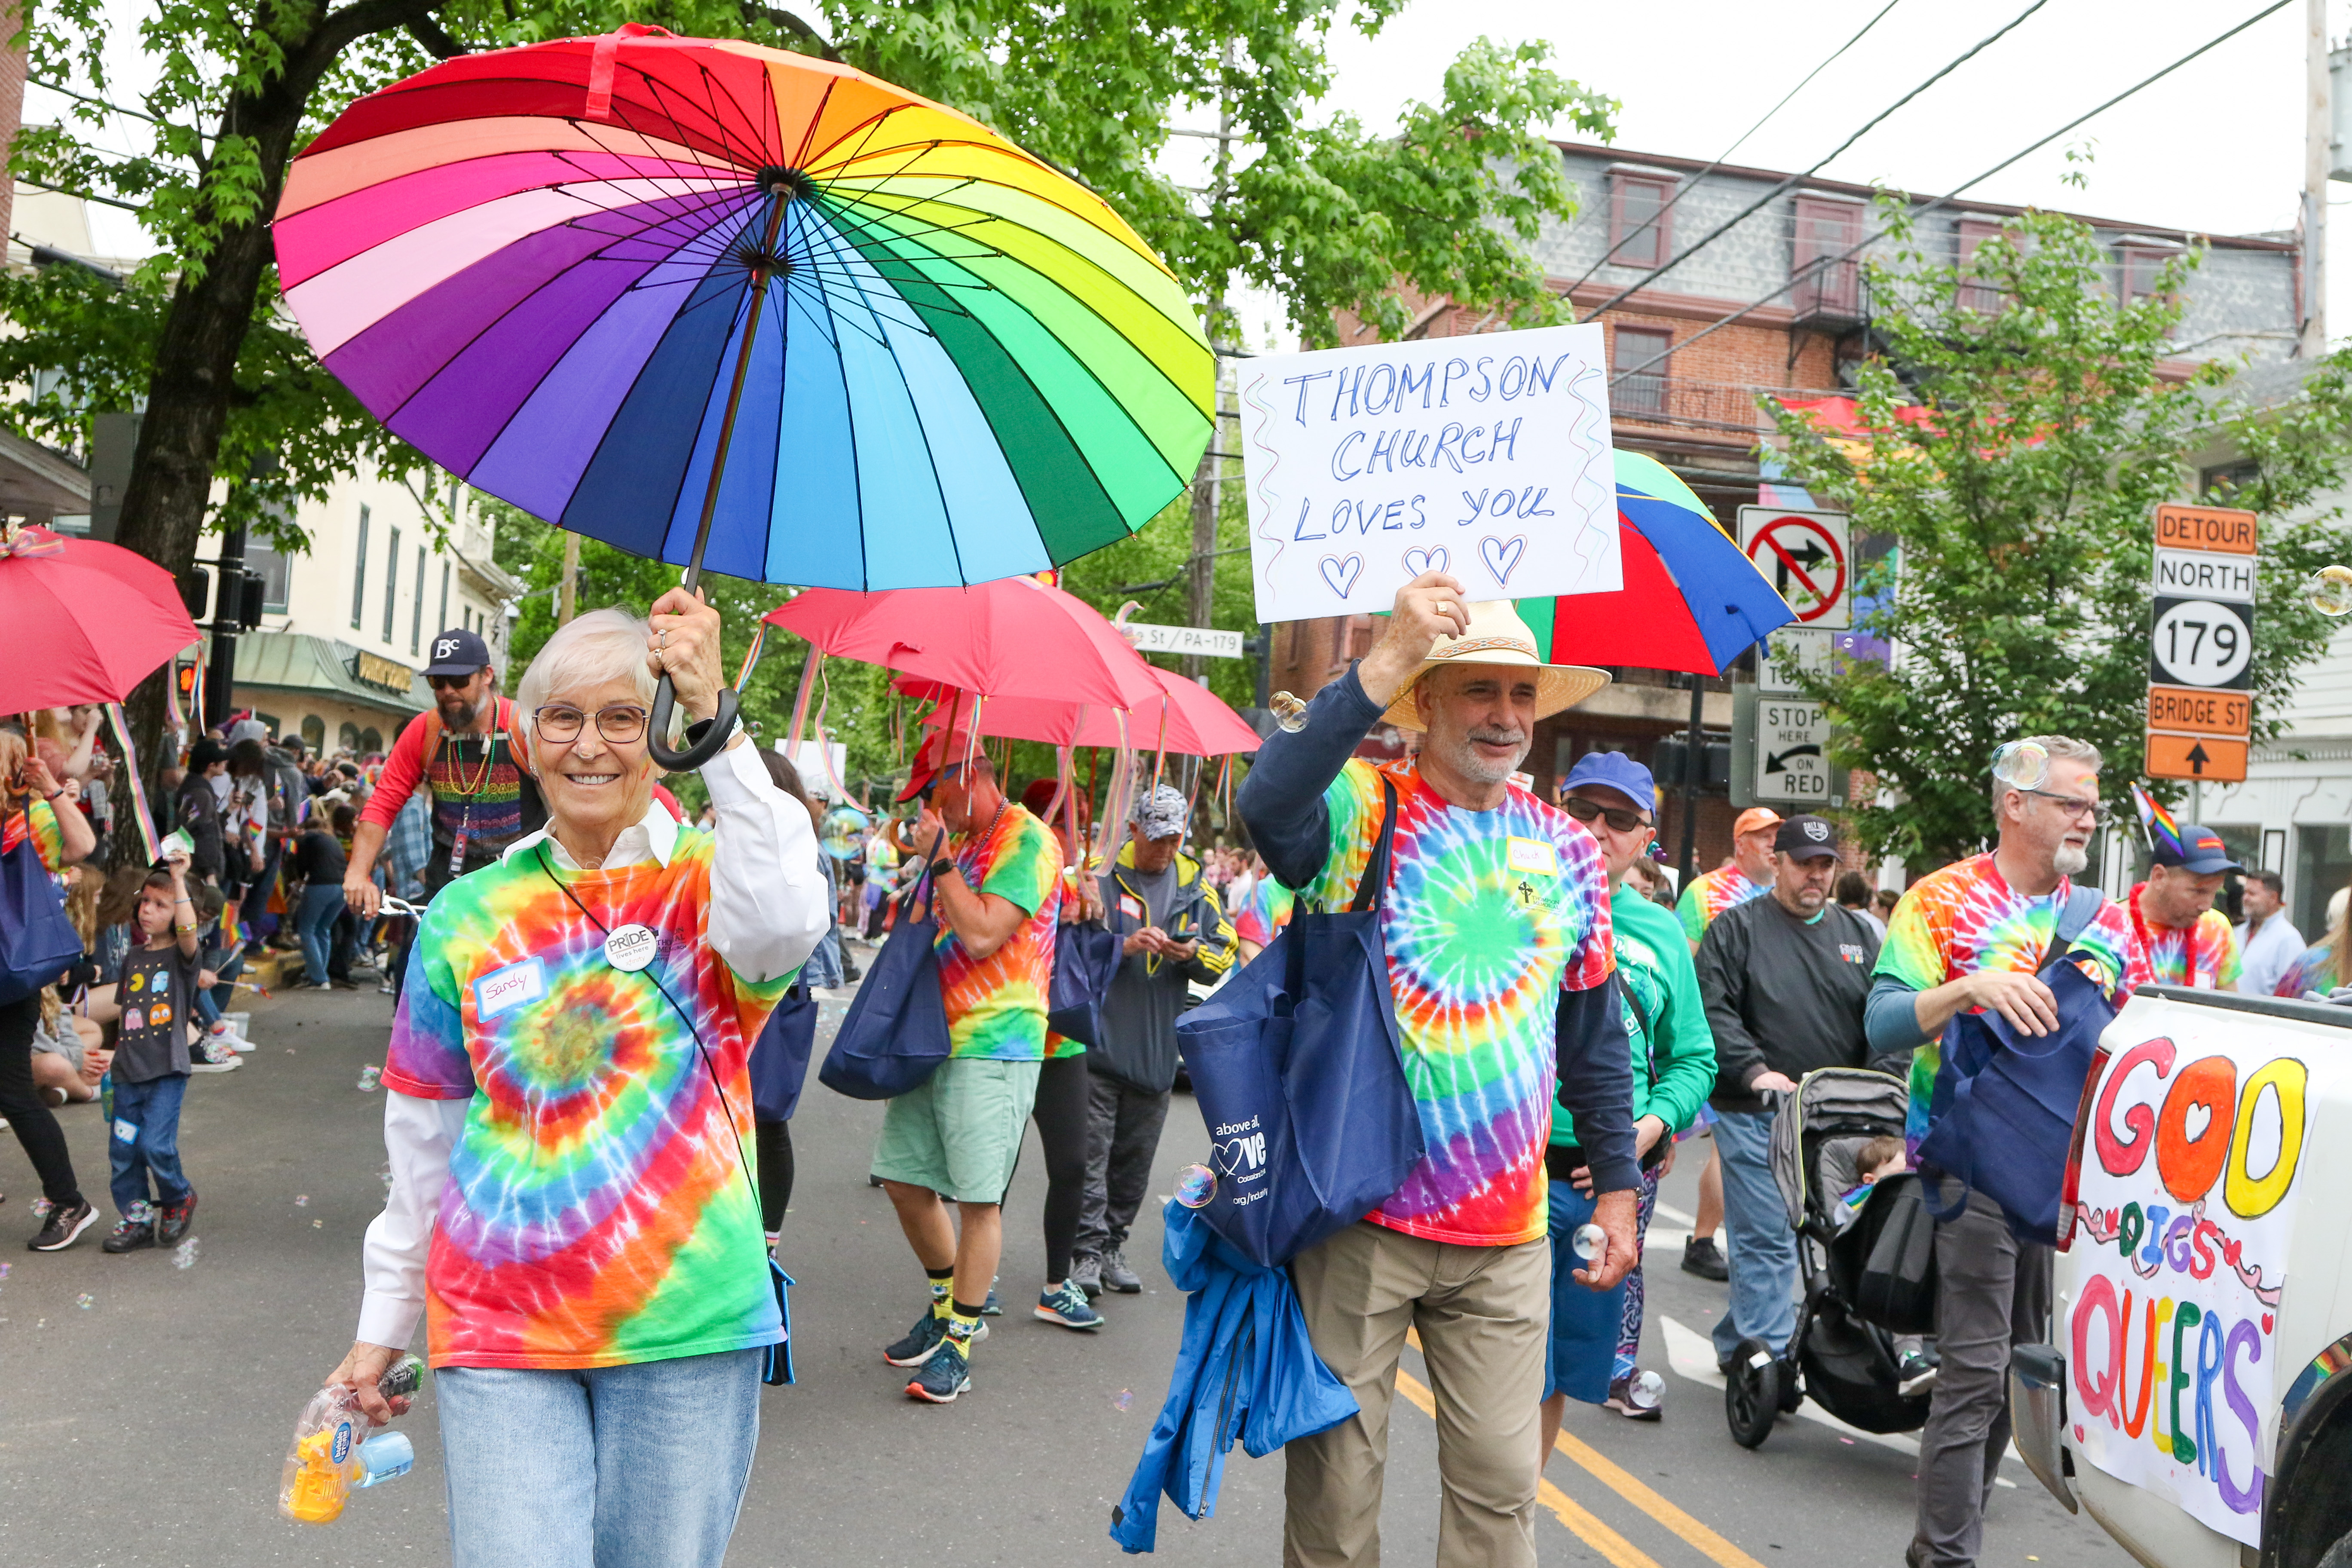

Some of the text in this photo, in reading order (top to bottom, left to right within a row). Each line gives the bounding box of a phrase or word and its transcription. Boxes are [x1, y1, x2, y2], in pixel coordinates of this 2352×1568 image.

[1283, 353, 1569, 427] THOMPSON
[1332, 417, 1523, 481] CHURCH
[1294, 486, 1555, 542] LOVES YOU
[2163, 515, 2251, 545] DETOUR
[2160, 560, 2250, 591] NORTH
[2168, 619, 2238, 667] 179
[1769, 707, 1822, 727] STOP
[2155, 696, 2246, 726] BRIDGE ST
[1779, 730, 1811, 742] HERE
[1798, 758, 1813, 770] ON
[1785, 775, 1824, 794] RED
[1513, 849, 1539, 859] Chuck
[1531, 895, 1560, 905] THOMPSON
[1533, 900, 1560, 910] MEMORIAL
[608, 930, 649, 952] PRIDE
[616, 951, 632, 959] lives
[486, 972, 527, 999] Sandy
[1216, 1121, 1251, 1136] above
[2119, 1201, 2215, 1280] DIGS
[2072, 1274, 2263, 1515] QUEERS
